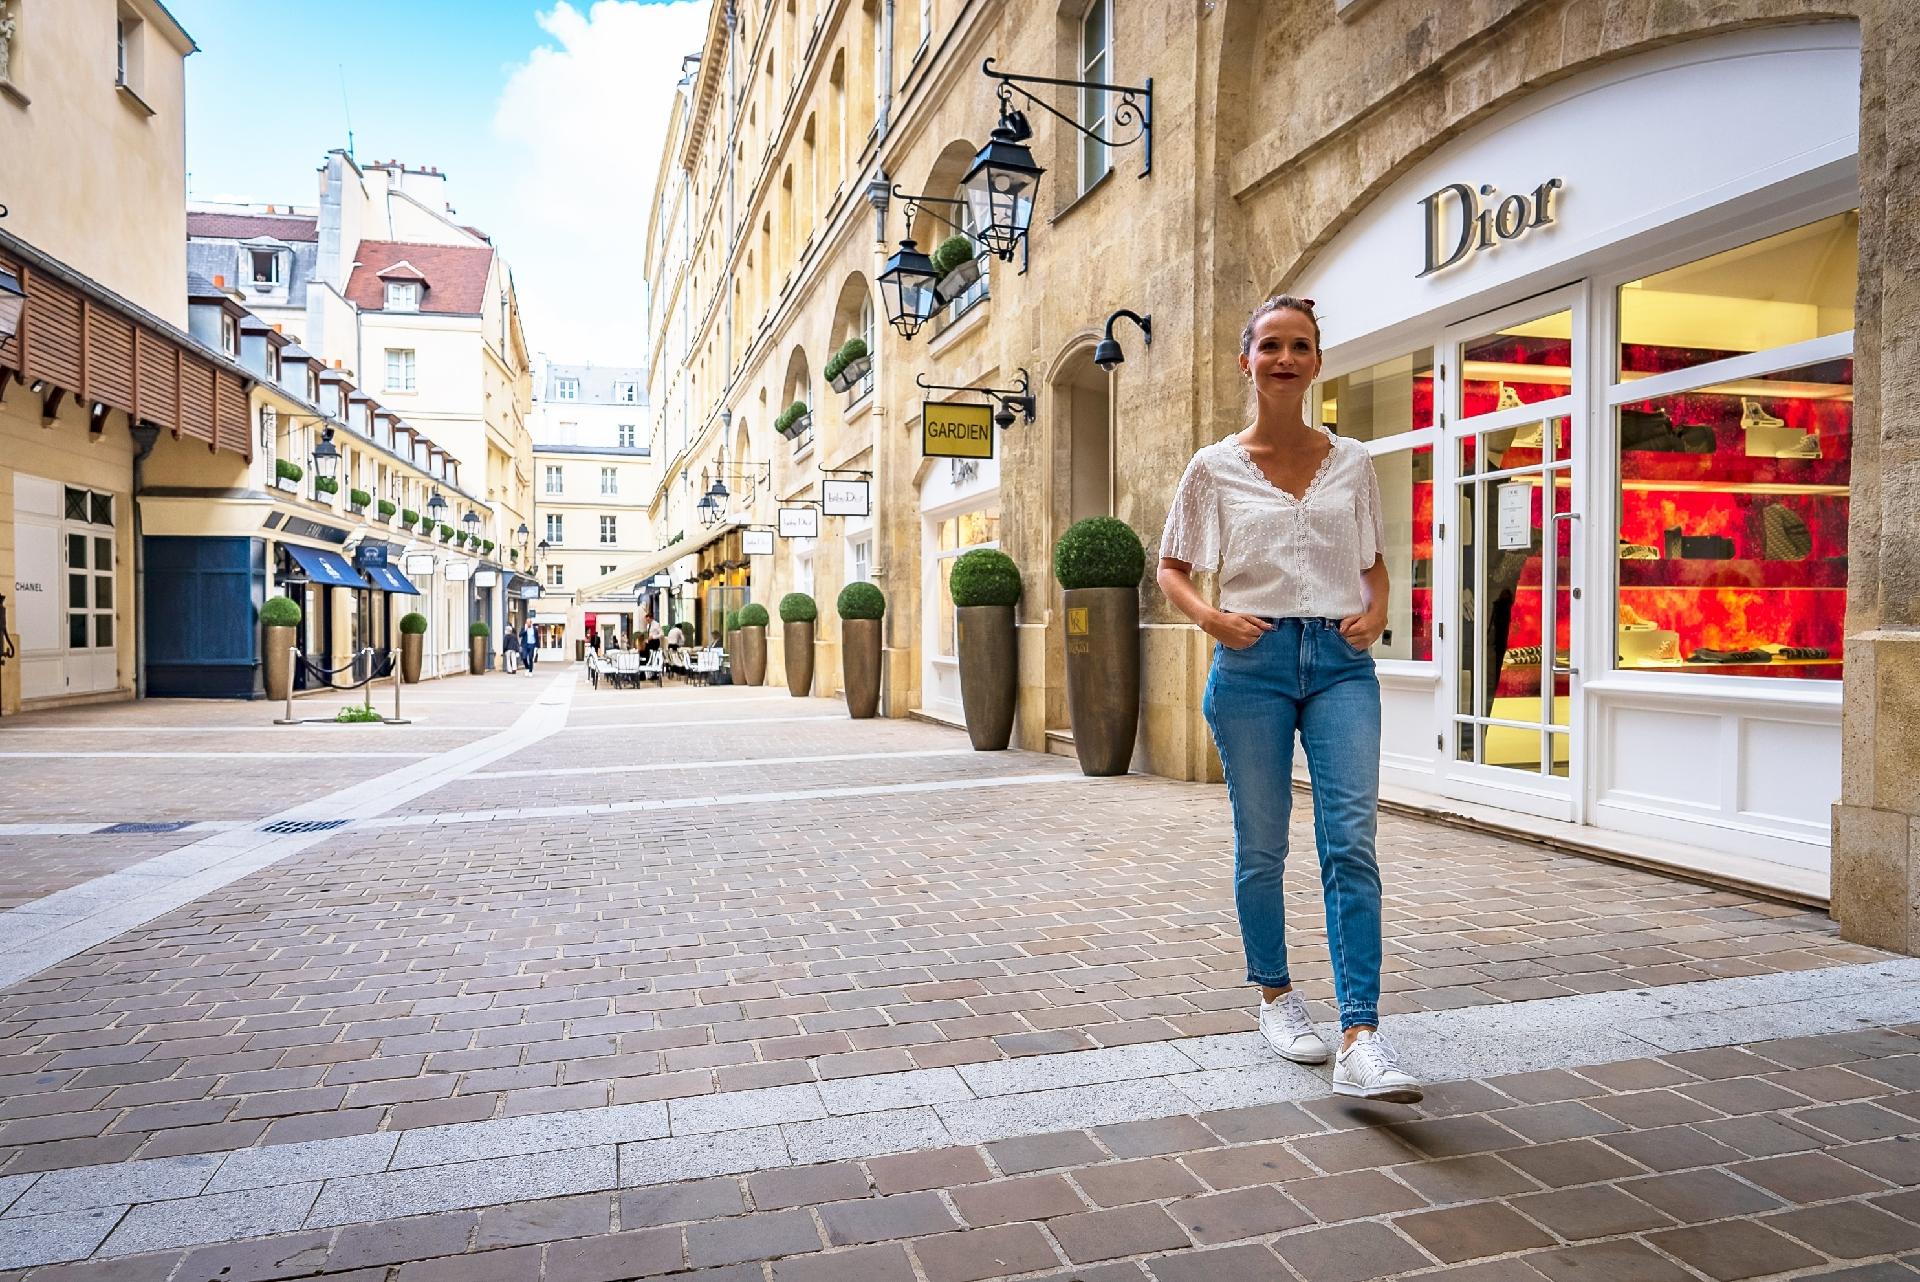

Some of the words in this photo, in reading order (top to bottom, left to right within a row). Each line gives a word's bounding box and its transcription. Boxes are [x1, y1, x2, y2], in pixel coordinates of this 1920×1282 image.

[1415, 178, 1562, 278] Dior
[928, 421, 989, 441] GARDIEN
[15, 582, 43, 592] CHANEL
